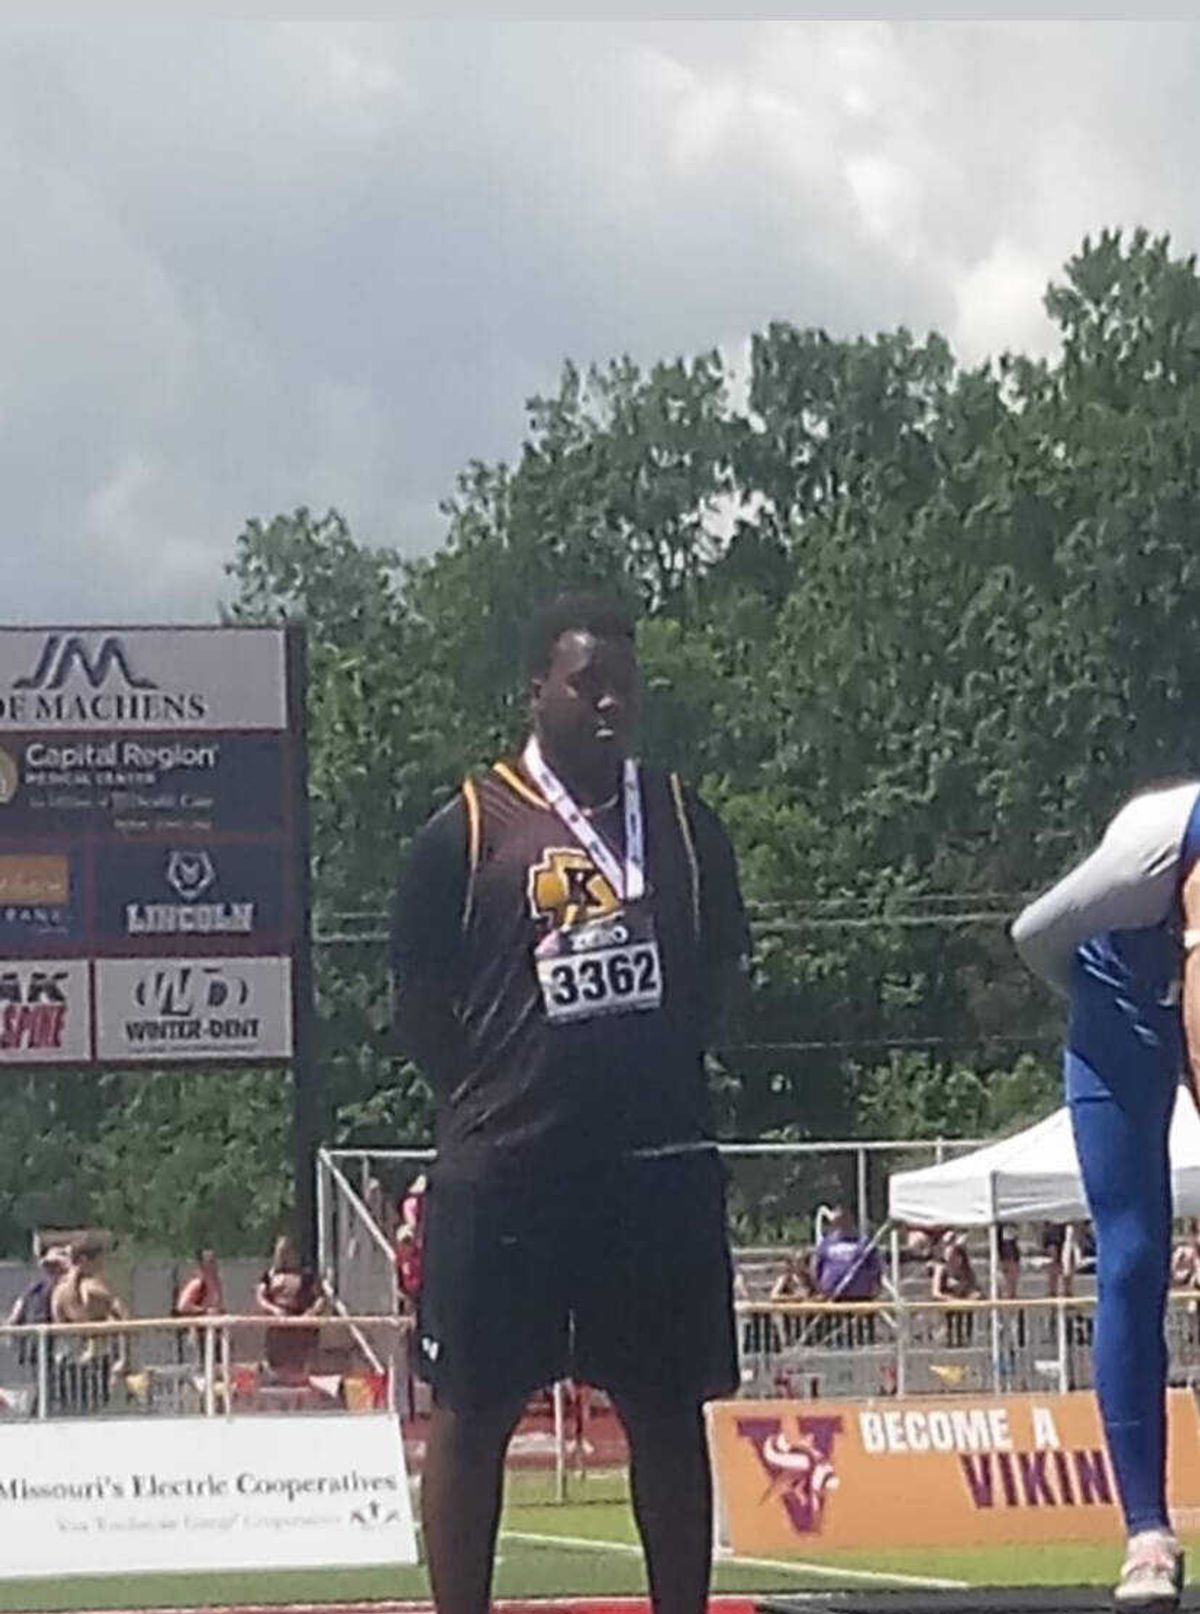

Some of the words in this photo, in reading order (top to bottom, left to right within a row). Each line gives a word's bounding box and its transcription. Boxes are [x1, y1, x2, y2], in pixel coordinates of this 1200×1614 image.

[25, 743, 117, 768] Capital
[123, 743, 215, 769] Region
[126, 903, 253, 933] LINCOLN
[550, 951, 658, 1006] 3362
[126, 1019, 259, 1040] WINTER-DENT
[859, 1408, 1013, 1453] BECOME
[1032, 1407, 1060, 1449] A
[0, 1476, 124, 1501] Missouri's
[132, 1474, 228, 1497] Electric
[236, 1470, 398, 1501] Cooperatives
